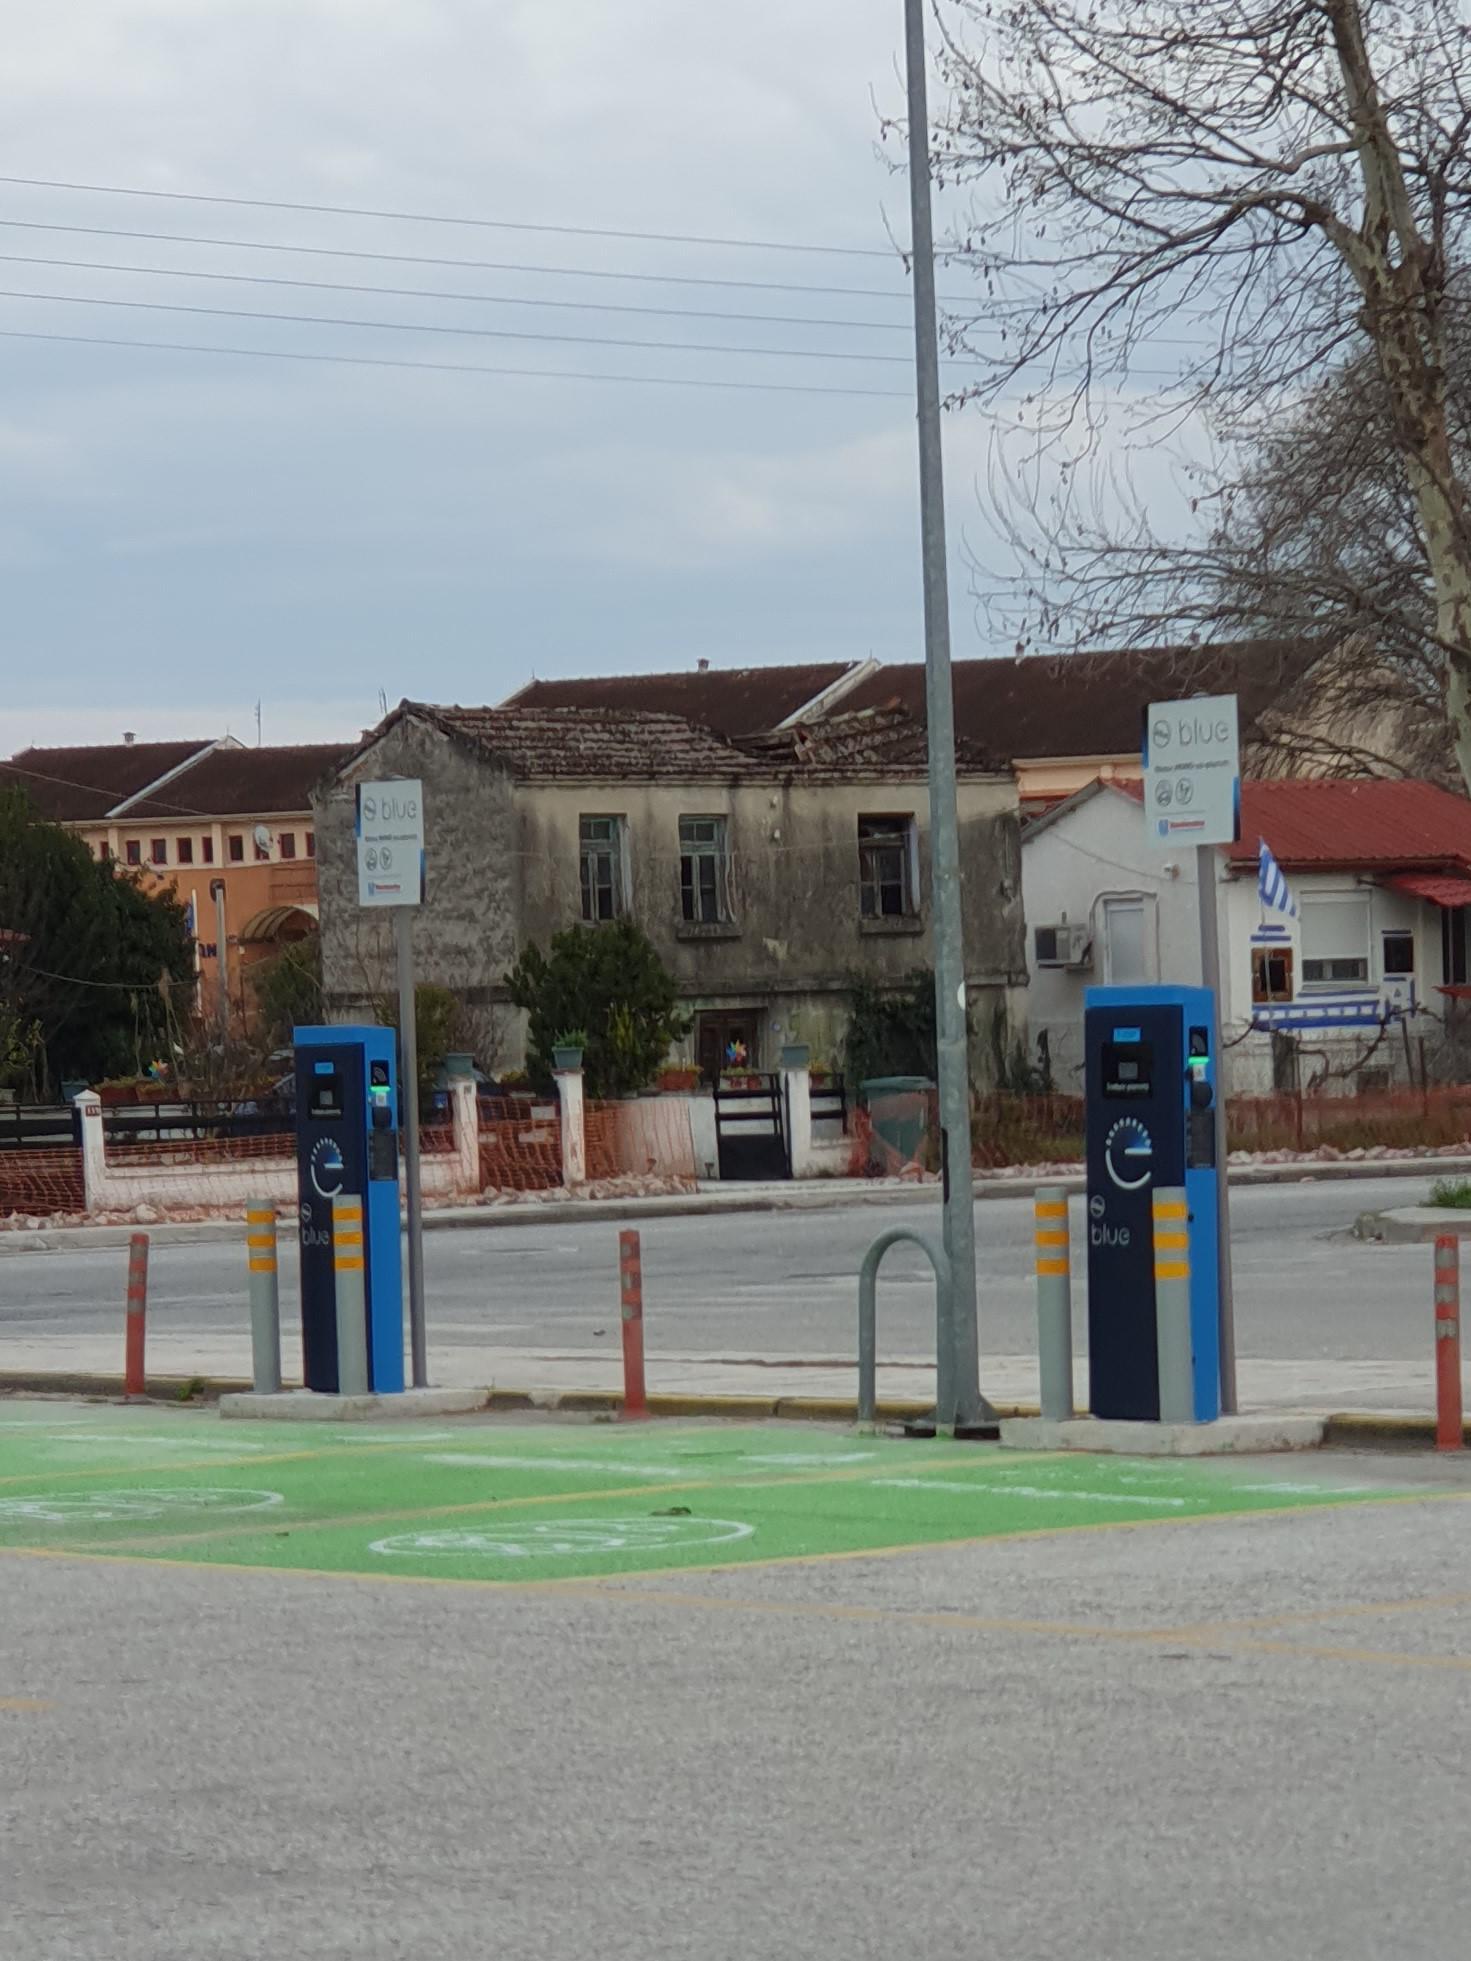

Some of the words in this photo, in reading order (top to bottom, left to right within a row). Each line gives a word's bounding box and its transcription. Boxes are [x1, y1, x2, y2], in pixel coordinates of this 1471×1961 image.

[1179, 716, 1229, 746] blue
[381, 797, 417, 820] blue
[302, 1225, 329, 1246] blue
[1091, 1224, 1130, 1245] blue
